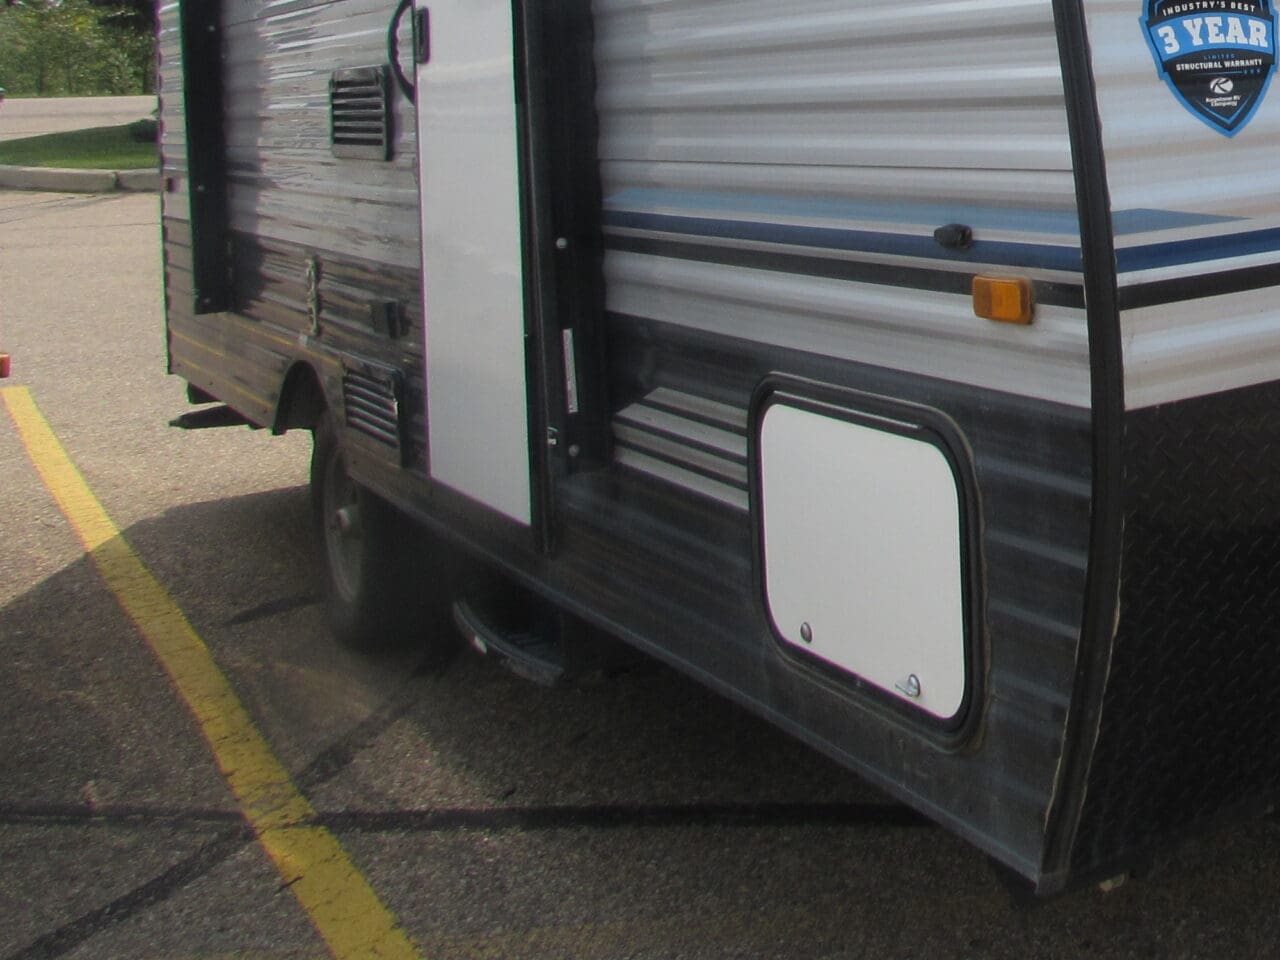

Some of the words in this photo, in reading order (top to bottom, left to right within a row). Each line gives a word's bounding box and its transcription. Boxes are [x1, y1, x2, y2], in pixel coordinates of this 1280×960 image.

[1162, 0, 1227, 17] INDUSTRY'S
[1231, 1, 1256, 13] BEST
[1157, 25, 1181, 55] 3
[1183, 16, 1269, 48] YEAR
[1175, 60, 1223, 71] STRUCTURAL
[1224, 58, 1263, 68] WARRANTY
